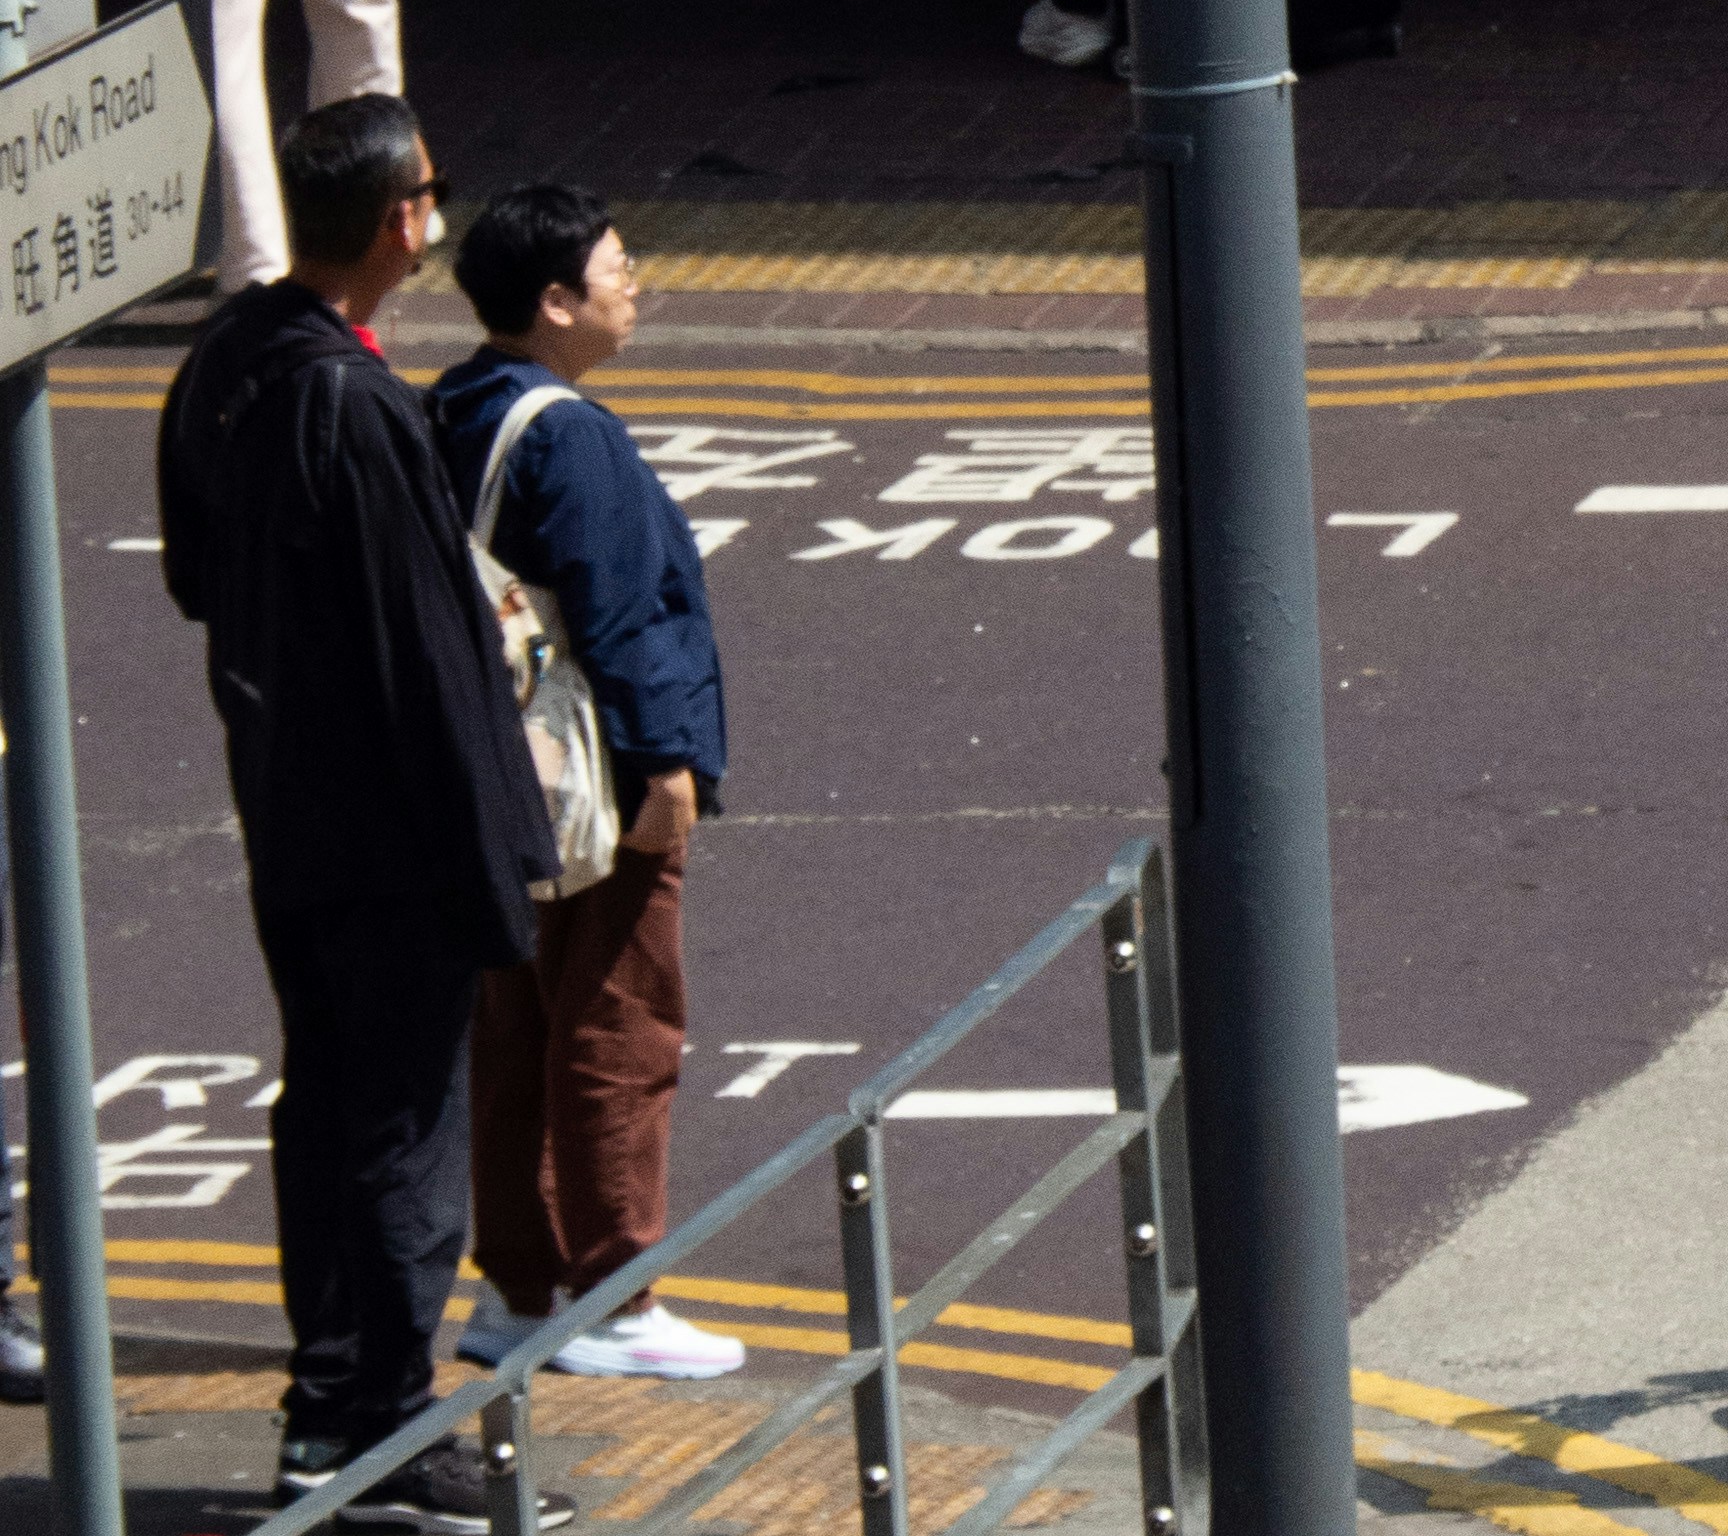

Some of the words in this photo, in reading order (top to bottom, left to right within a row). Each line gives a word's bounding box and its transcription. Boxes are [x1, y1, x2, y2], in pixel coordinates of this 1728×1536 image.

[32, 94, 83, 170] Kok
[89, 52, 156, 142] Road
[12, 188, 119, 316] 旺角道
[789, 512, 1461, 559] LOK
